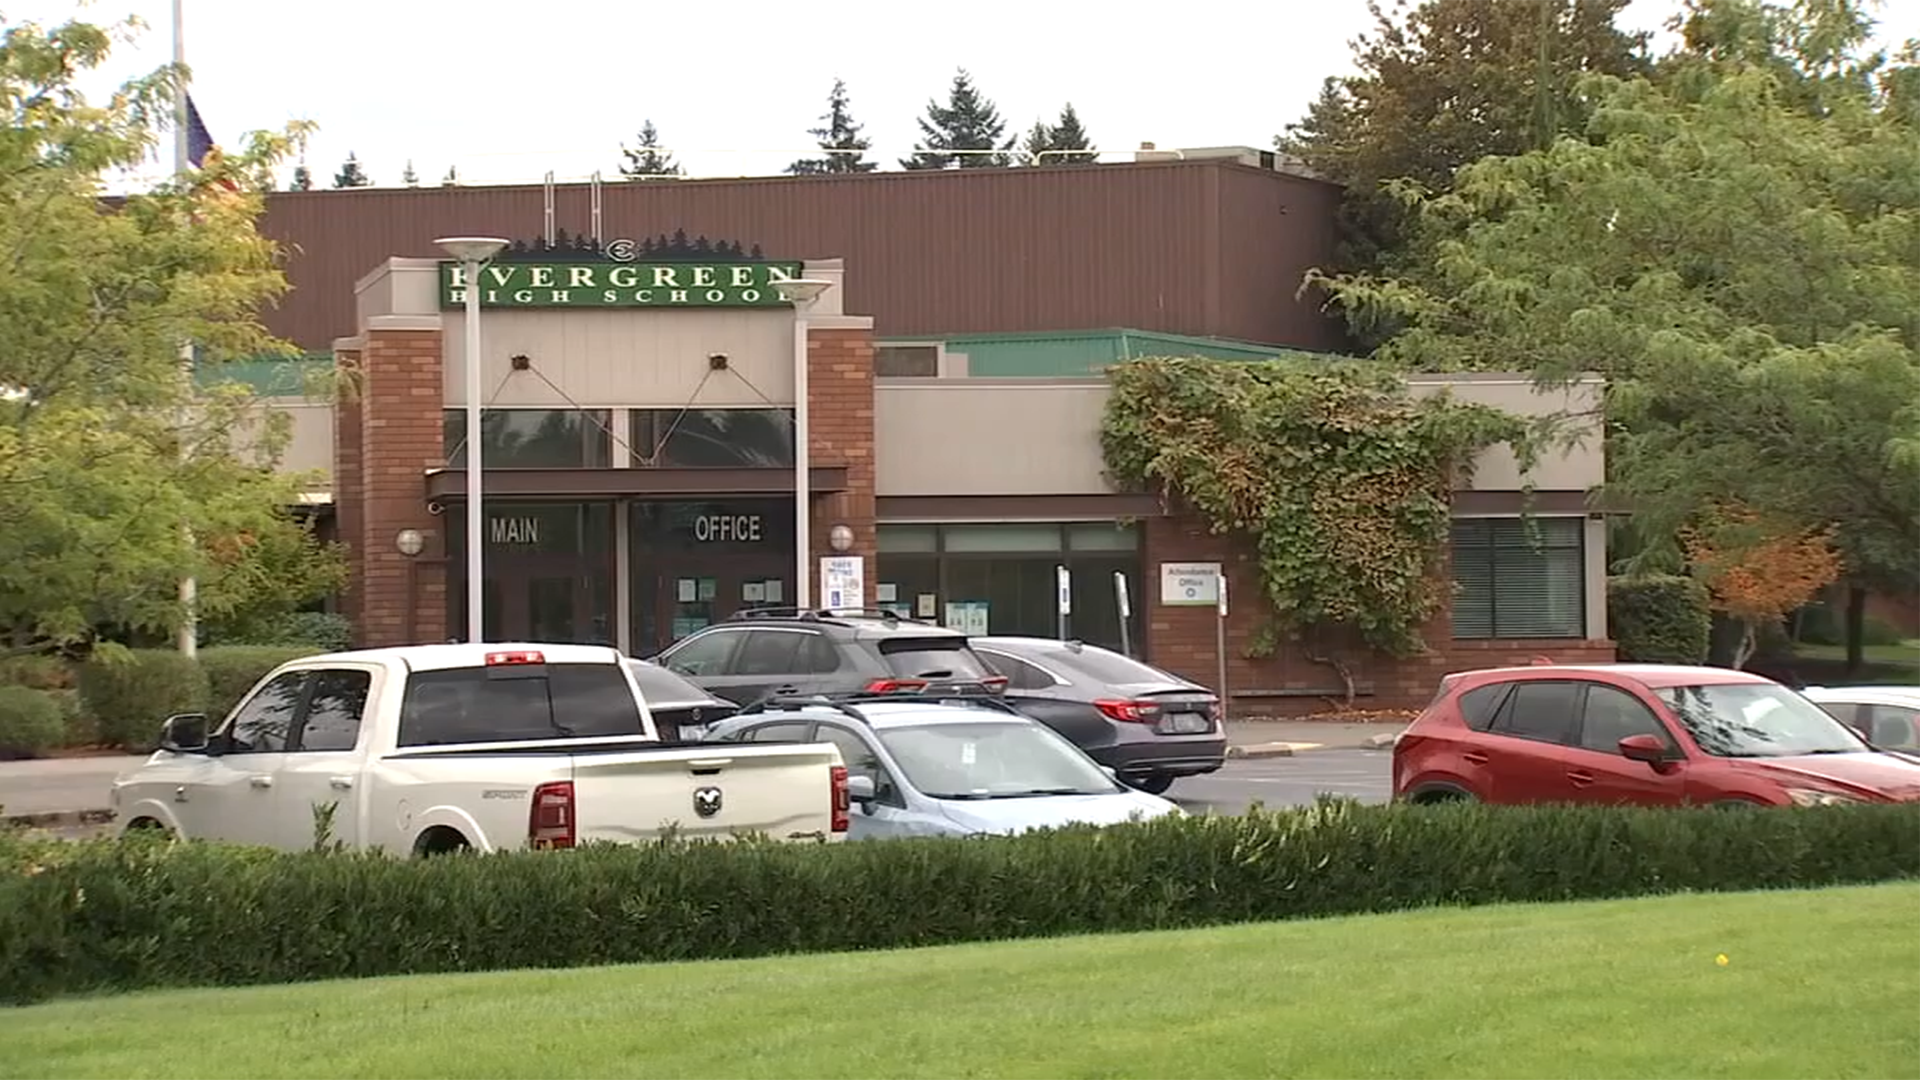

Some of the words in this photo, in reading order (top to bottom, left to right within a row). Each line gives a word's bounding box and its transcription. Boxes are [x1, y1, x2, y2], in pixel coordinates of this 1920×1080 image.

[450, 267, 793, 287] EVERGREEN
[451, 290, 570, 303] HIGH
[491, 518, 538, 542] MAIN
[695, 516, 760, 540] OFFICE
